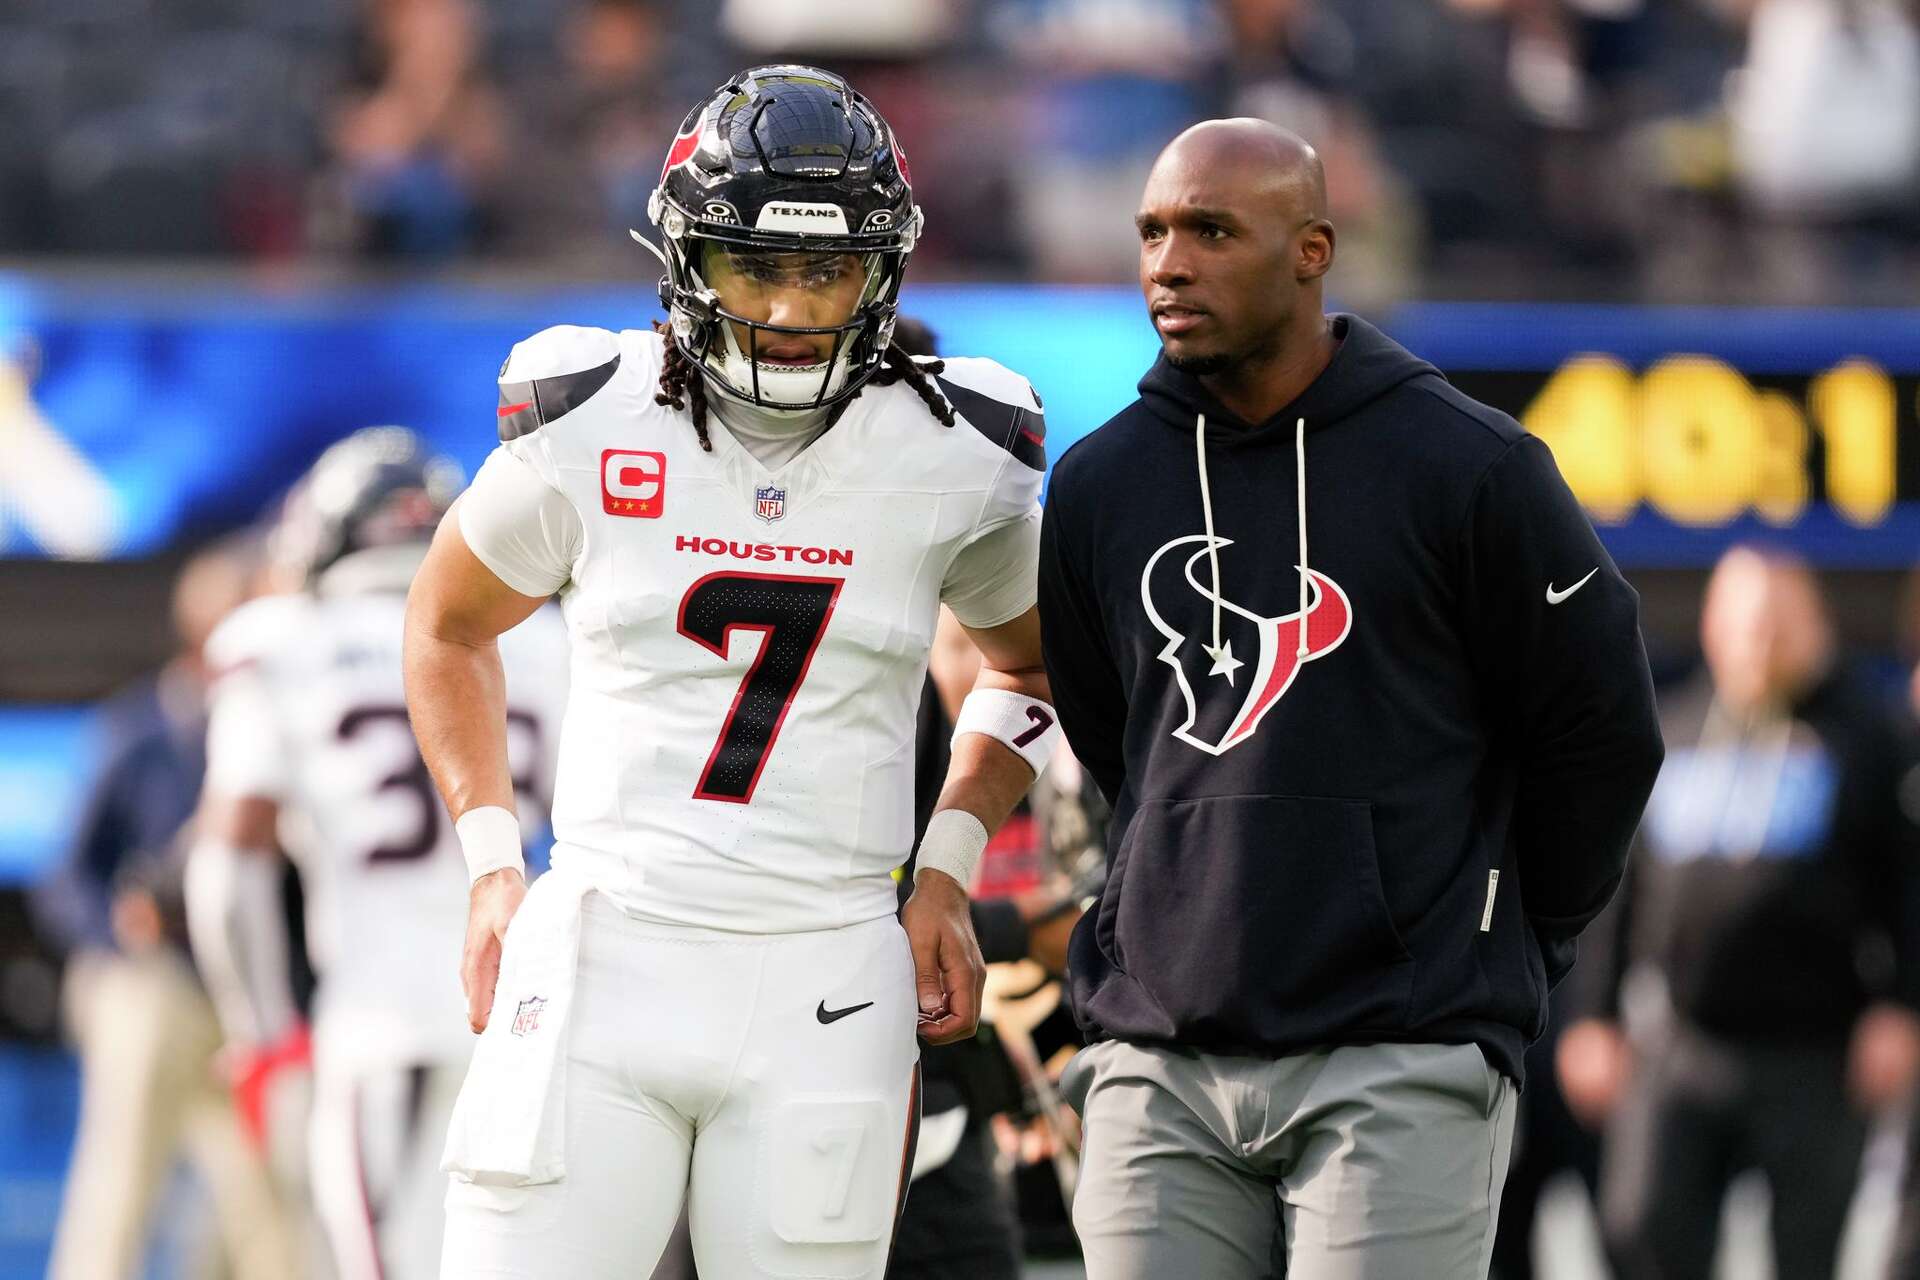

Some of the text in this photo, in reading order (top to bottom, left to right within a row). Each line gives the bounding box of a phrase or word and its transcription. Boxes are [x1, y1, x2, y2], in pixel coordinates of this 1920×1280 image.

[701, 213, 737, 225] OAKLEY
[770, 206, 838, 218] TEXANS
[865, 223, 893, 232] OAKLEY
[604, 452, 661, 500] C
[759, 500, 782, 517] NFL
[675, 535, 854, 567] HOUSTON
[676, 570, 845, 804] 7
[1012, 705, 1055, 749] 7
[514, 1012, 540, 1033] NFL
[809, 1120, 866, 1221] 7
